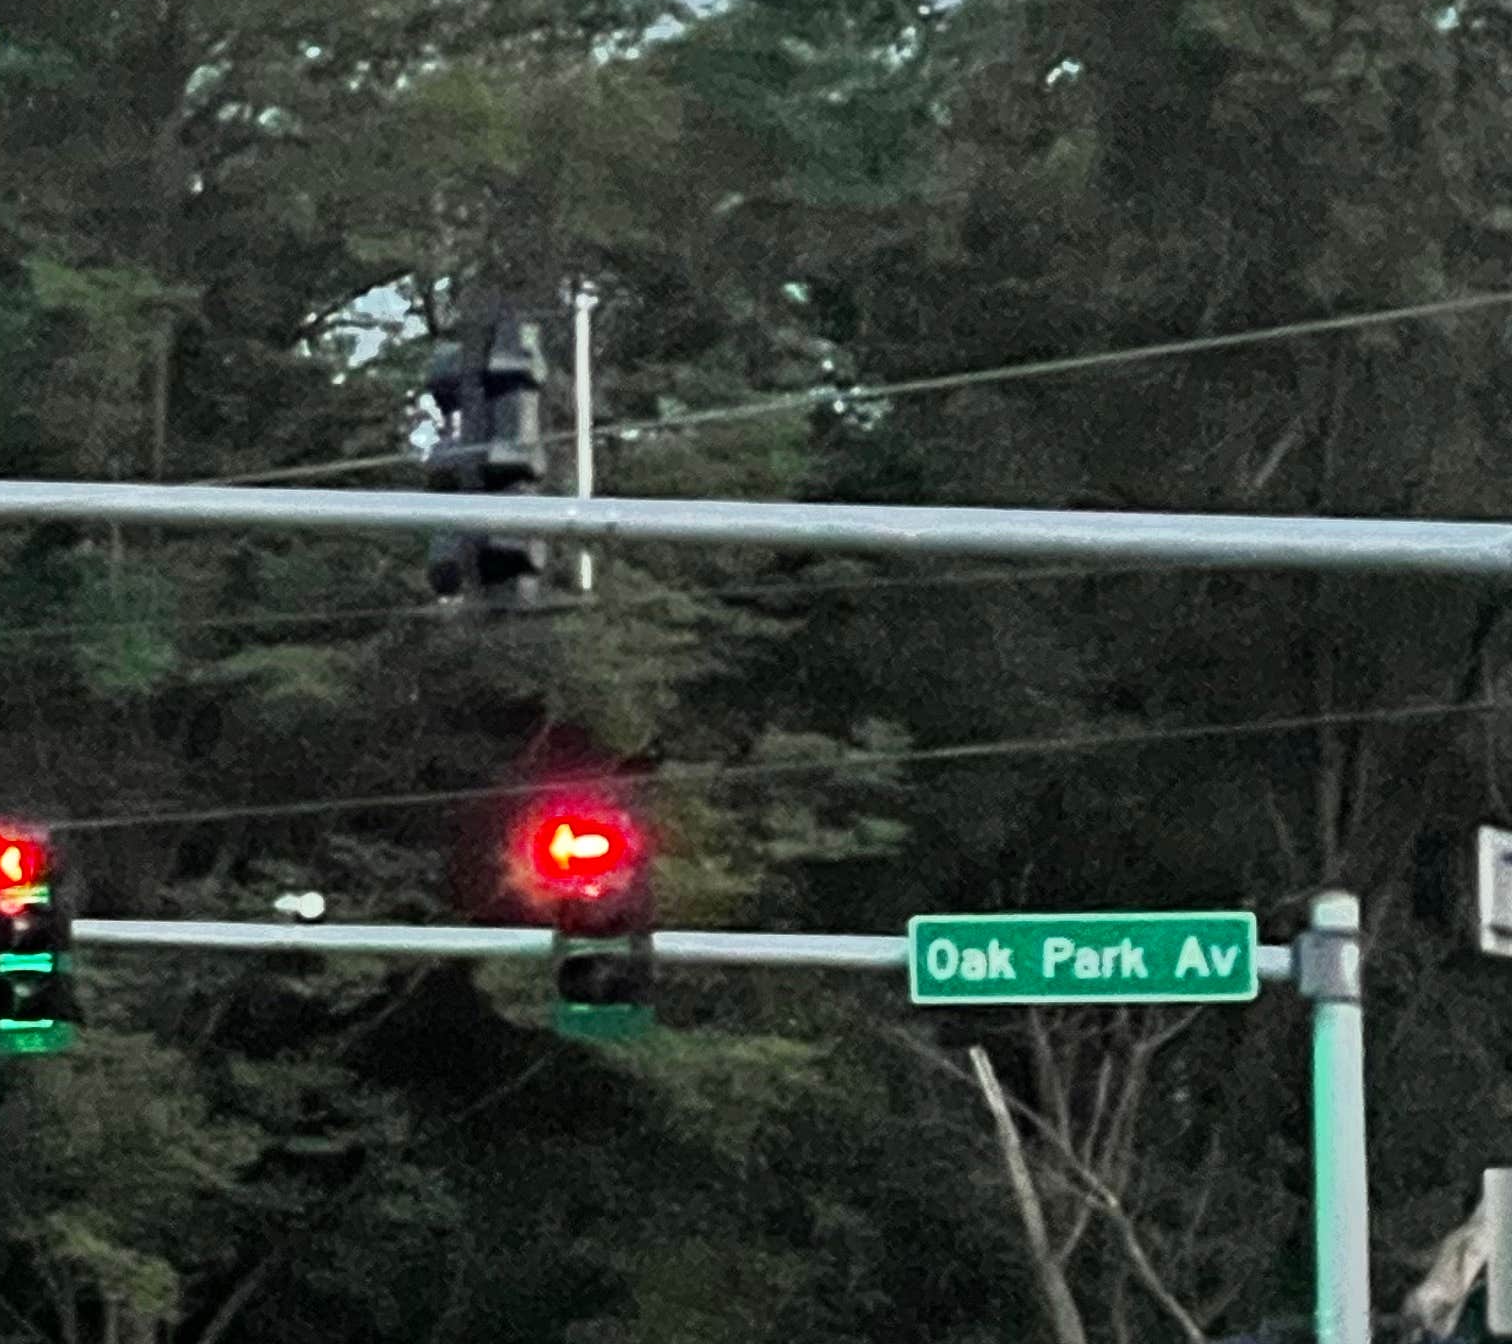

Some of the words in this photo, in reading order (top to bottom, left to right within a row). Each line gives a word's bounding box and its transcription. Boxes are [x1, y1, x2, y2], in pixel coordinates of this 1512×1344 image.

[926, 938, 1017, 981] Oak
[1042, 936, 1148, 979] Park
[1174, 935, 1240, 979] Av
